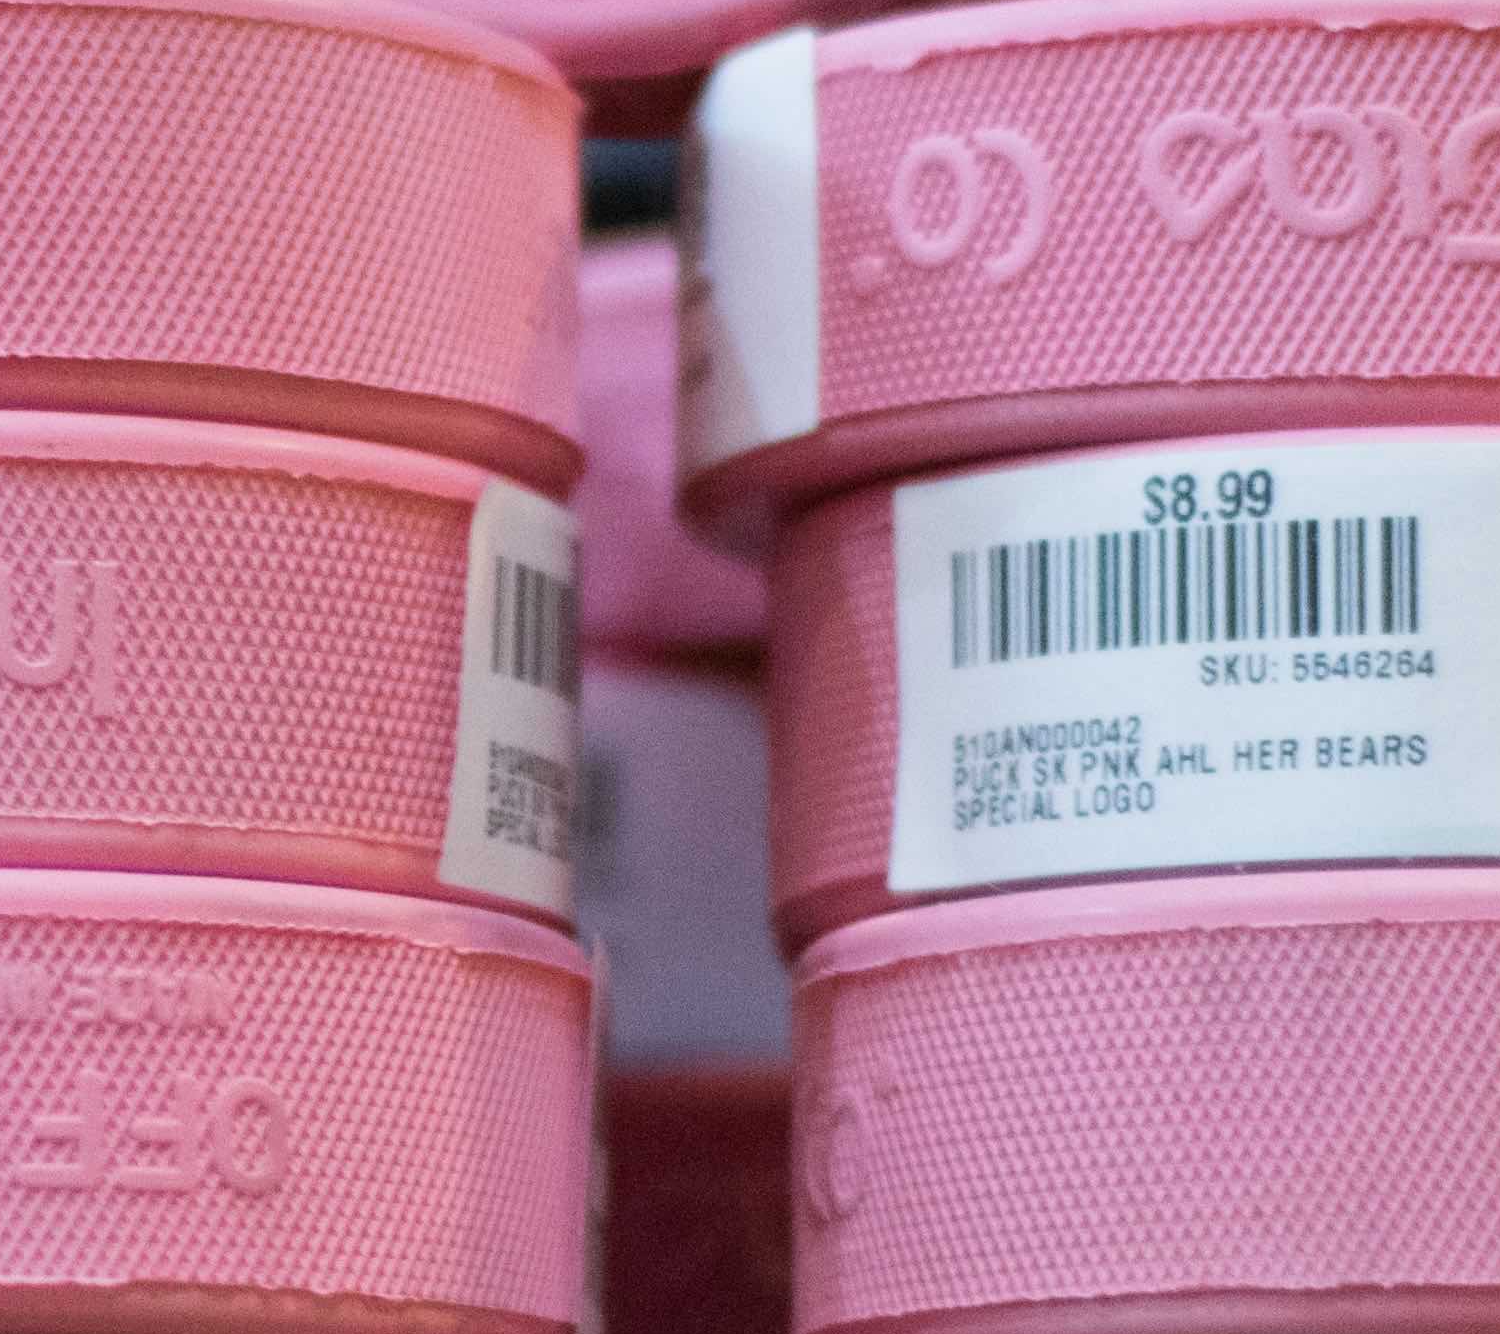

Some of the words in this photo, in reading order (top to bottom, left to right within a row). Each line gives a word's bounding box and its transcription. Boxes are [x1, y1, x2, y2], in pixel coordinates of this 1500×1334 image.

[1143, 469, 1274, 525] $8.99
[1200, 654, 1280, 687] SKU:
[1292, 650, 1436, 684] 5546264
[953, 753, 1022, 796] PUCK
[1032, 753, 1069, 786] SK
[1081, 747, 1142, 783] PNK
[1156, 743, 1217, 776] AHL
[1233, 738, 1299, 772] HER
[1315, 734, 1429, 769] BEARS
[953, 790, 1061, 832] SPECIAL
[1073, 782, 1156, 819] LOGO
